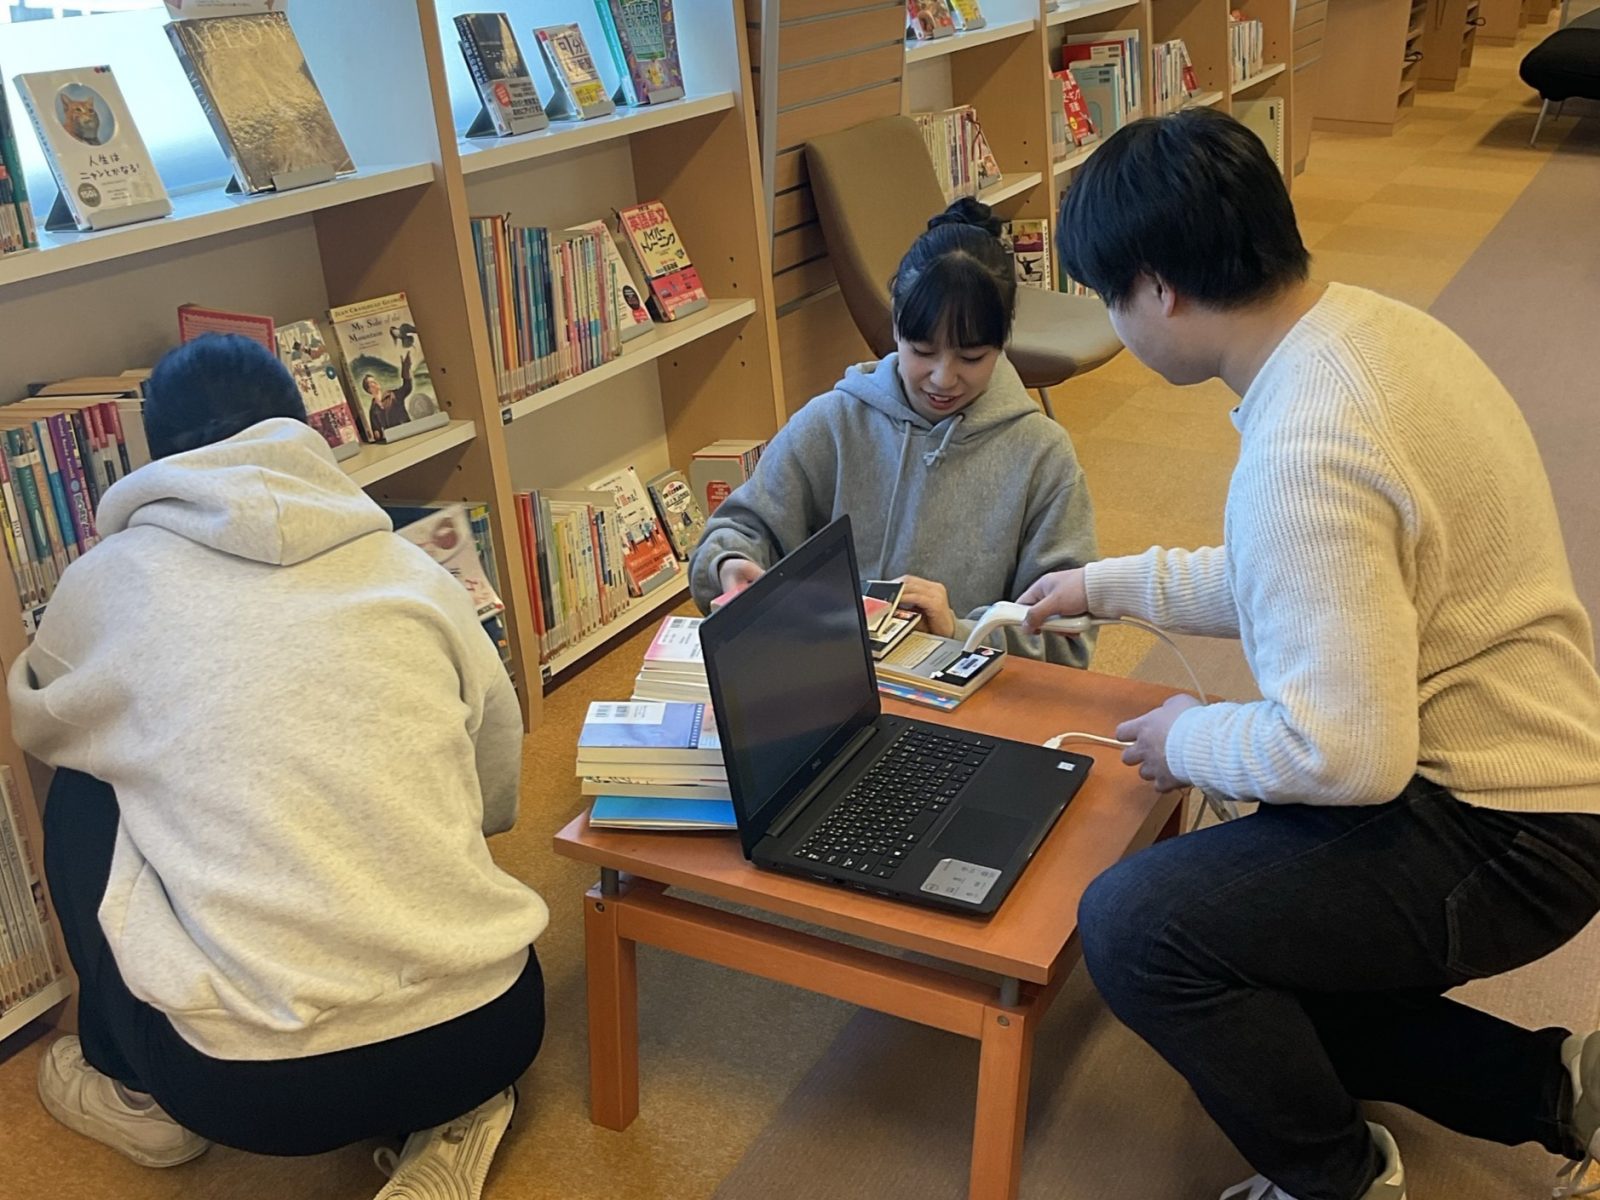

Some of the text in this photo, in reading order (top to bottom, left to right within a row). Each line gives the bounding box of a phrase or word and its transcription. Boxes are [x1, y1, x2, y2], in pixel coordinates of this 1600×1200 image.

[622, 2, 659, 16] SUPER
[89, 152, 120, 167] 人生は
[627, 207, 669, 232] 英語長文
